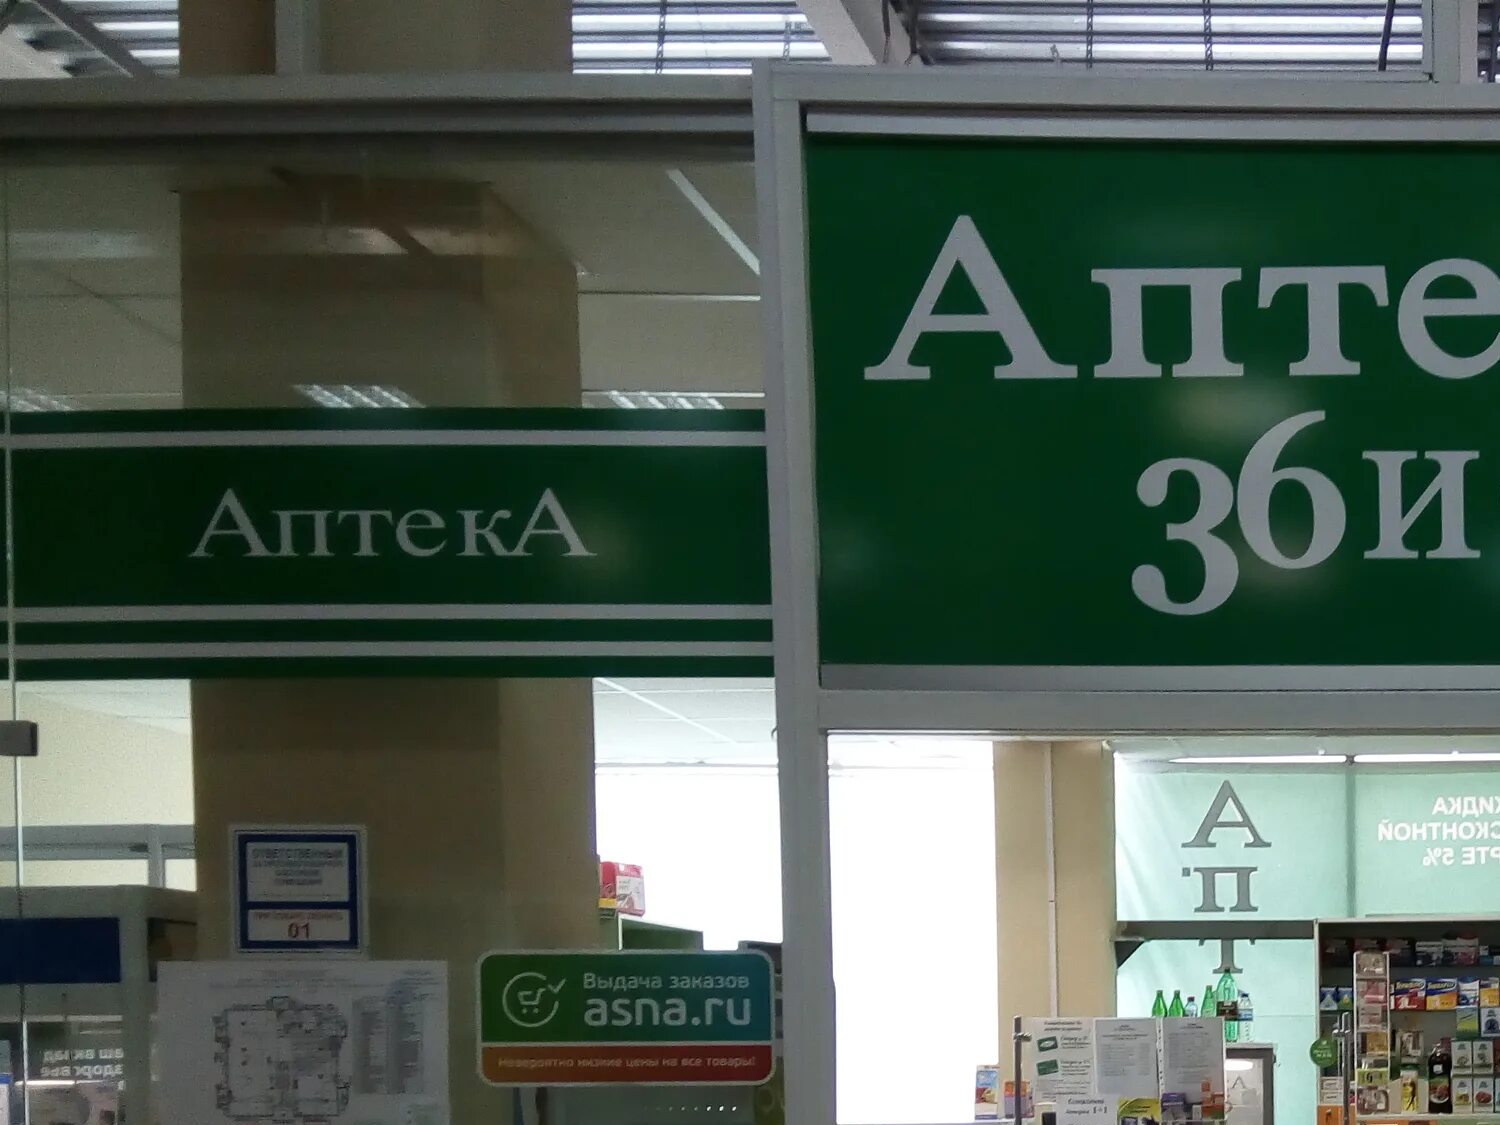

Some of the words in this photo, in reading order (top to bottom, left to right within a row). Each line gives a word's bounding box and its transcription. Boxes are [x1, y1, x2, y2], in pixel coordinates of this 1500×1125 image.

[187, 487, 598, 558] АптекА
[287, 921, 311, 939] 01
[582, 972, 664, 992] Выдача
[669, 974, 751, 990] заказов
[583, 996, 752, 1027] asna.ru
[497, 1056, 575, 1070] Невероятно
[577, 1056, 623, 1068] низкие
[625, 1056, 660, 1069] цены
[662, 1057, 679, 1067] на
[680, 1056, 704, 1067] все
[705, 1055, 757, 1069] товары!
